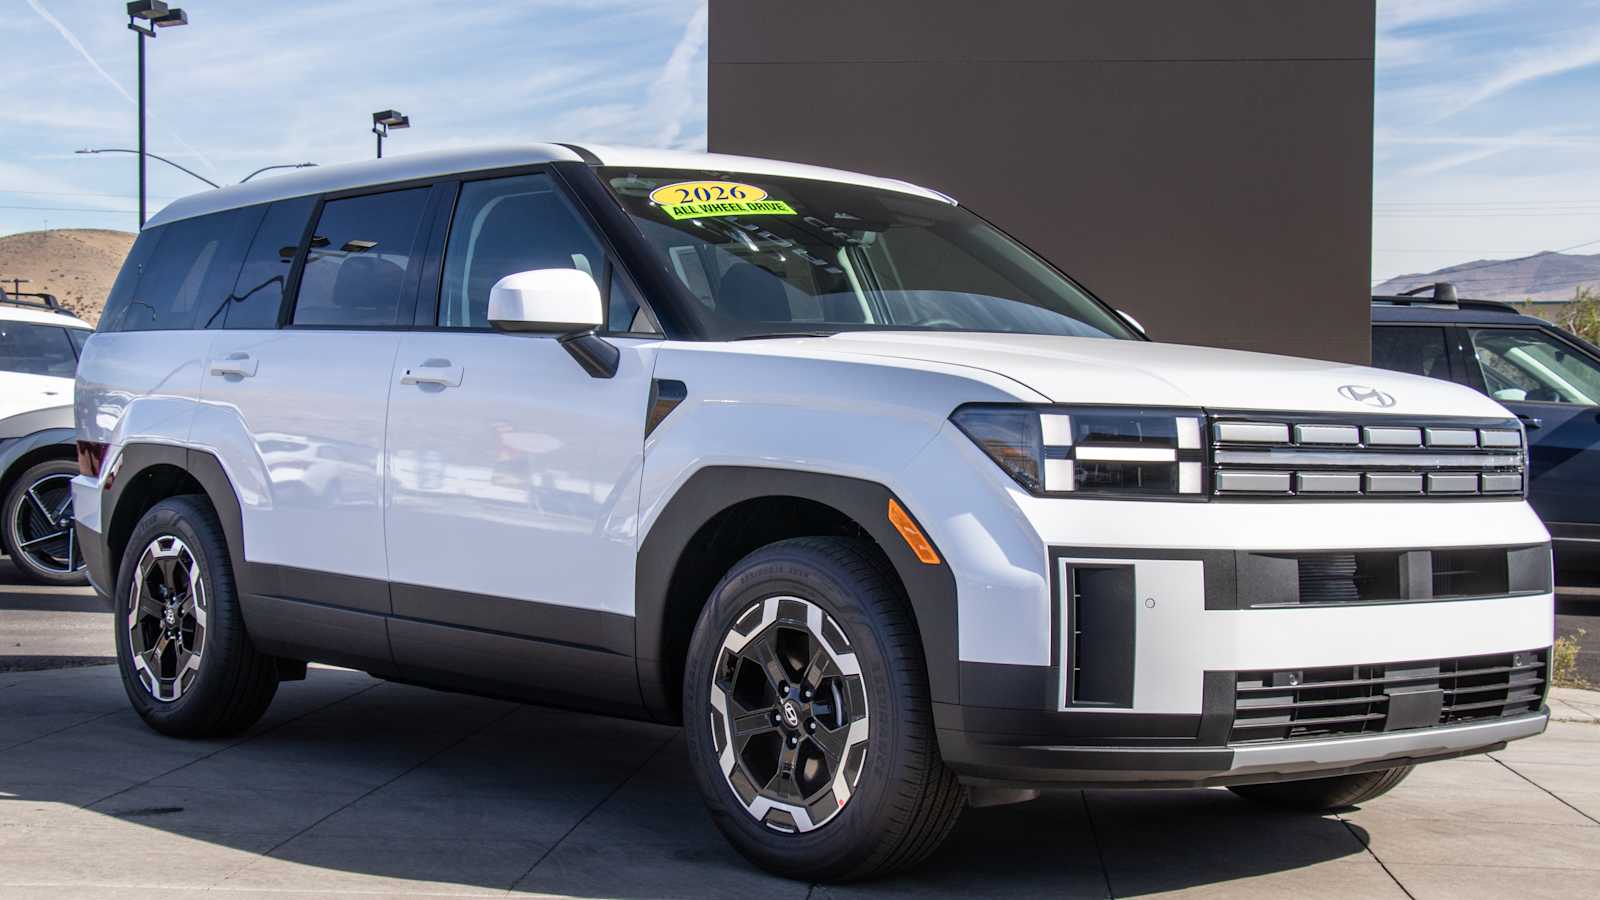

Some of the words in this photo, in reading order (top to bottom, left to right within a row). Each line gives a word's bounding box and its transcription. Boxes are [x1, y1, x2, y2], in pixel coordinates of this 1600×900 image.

[675, 186, 746, 203] 2026
[673, 205, 700, 215] ALL
[698, 203, 747, 213] WHEEL
[745, 202, 788, 212] DRIVE
